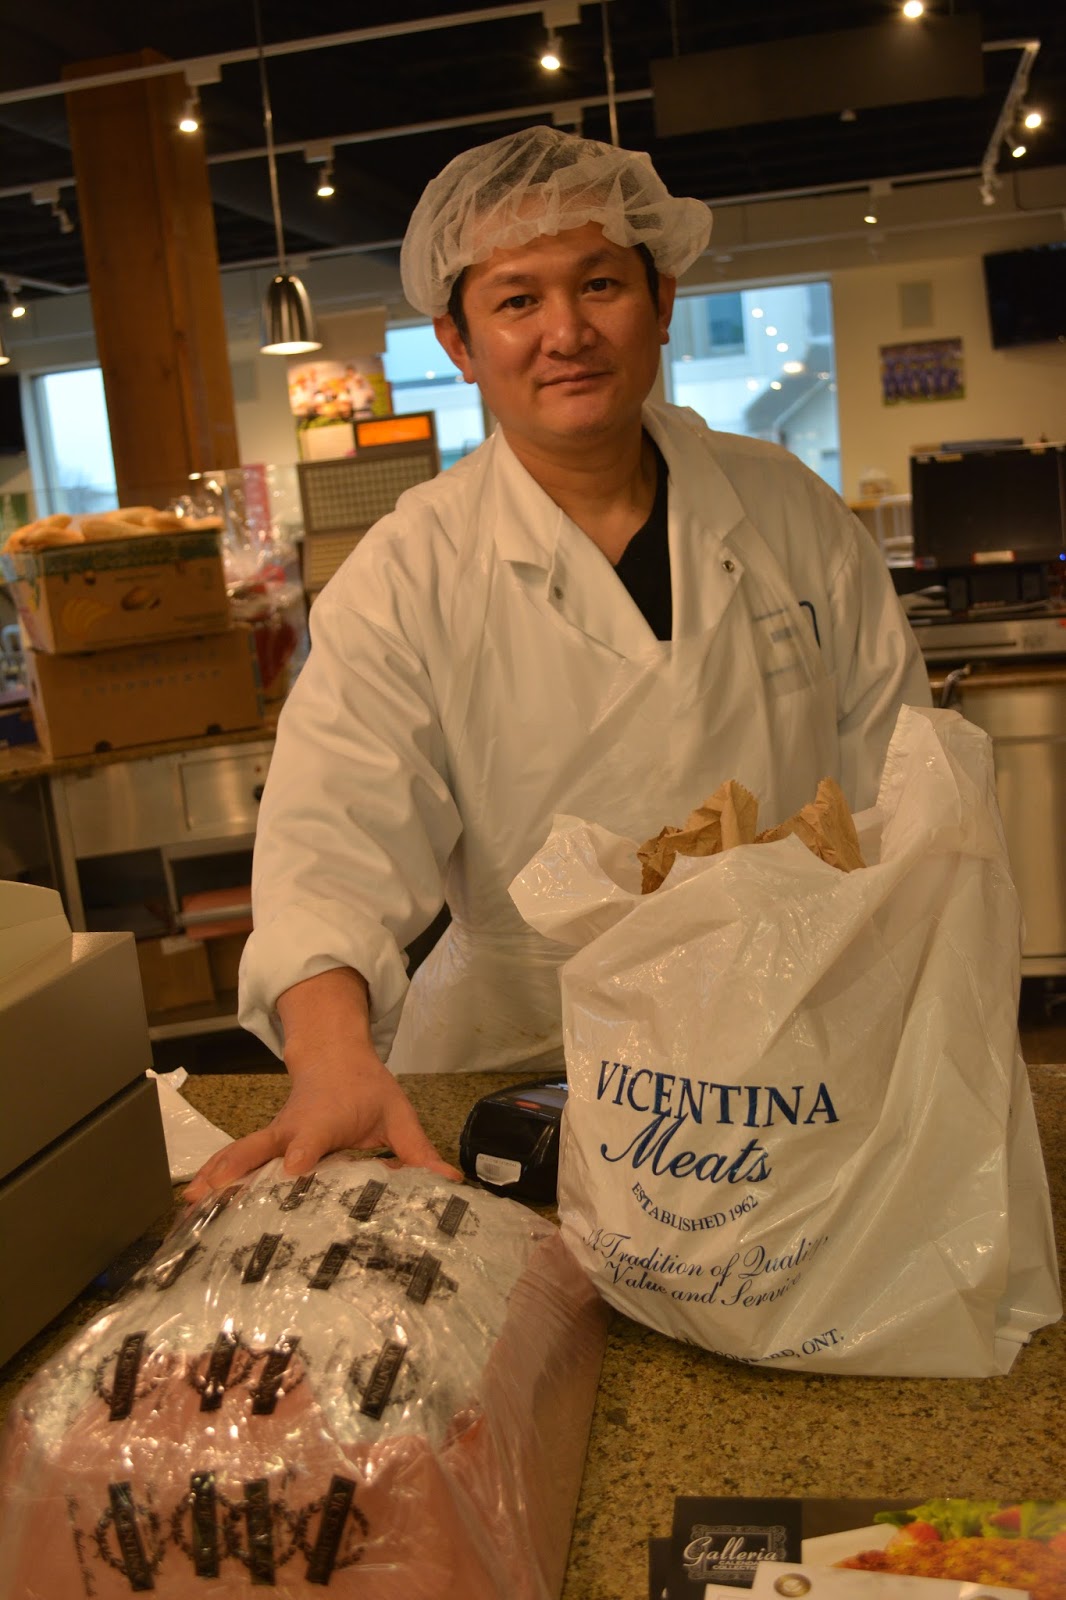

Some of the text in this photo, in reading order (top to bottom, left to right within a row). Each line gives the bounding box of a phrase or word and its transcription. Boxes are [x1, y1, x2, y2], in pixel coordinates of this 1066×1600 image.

[597, 1060, 839, 1128] VICENTINA
[600, 1112, 772, 1184] Meats
[632, 1181, 758, 1231] ESTABLISHED 1962
[600, 1232, 704, 1277] Tradition
[710, 1252, 740, 1287] of
[604, 1260, 668, 1294] Value
[671, 1281, 718, 1304] and
[802, 1328, 845, 1356] ONT.
[683, 1536, 778, 1567] Galleria
